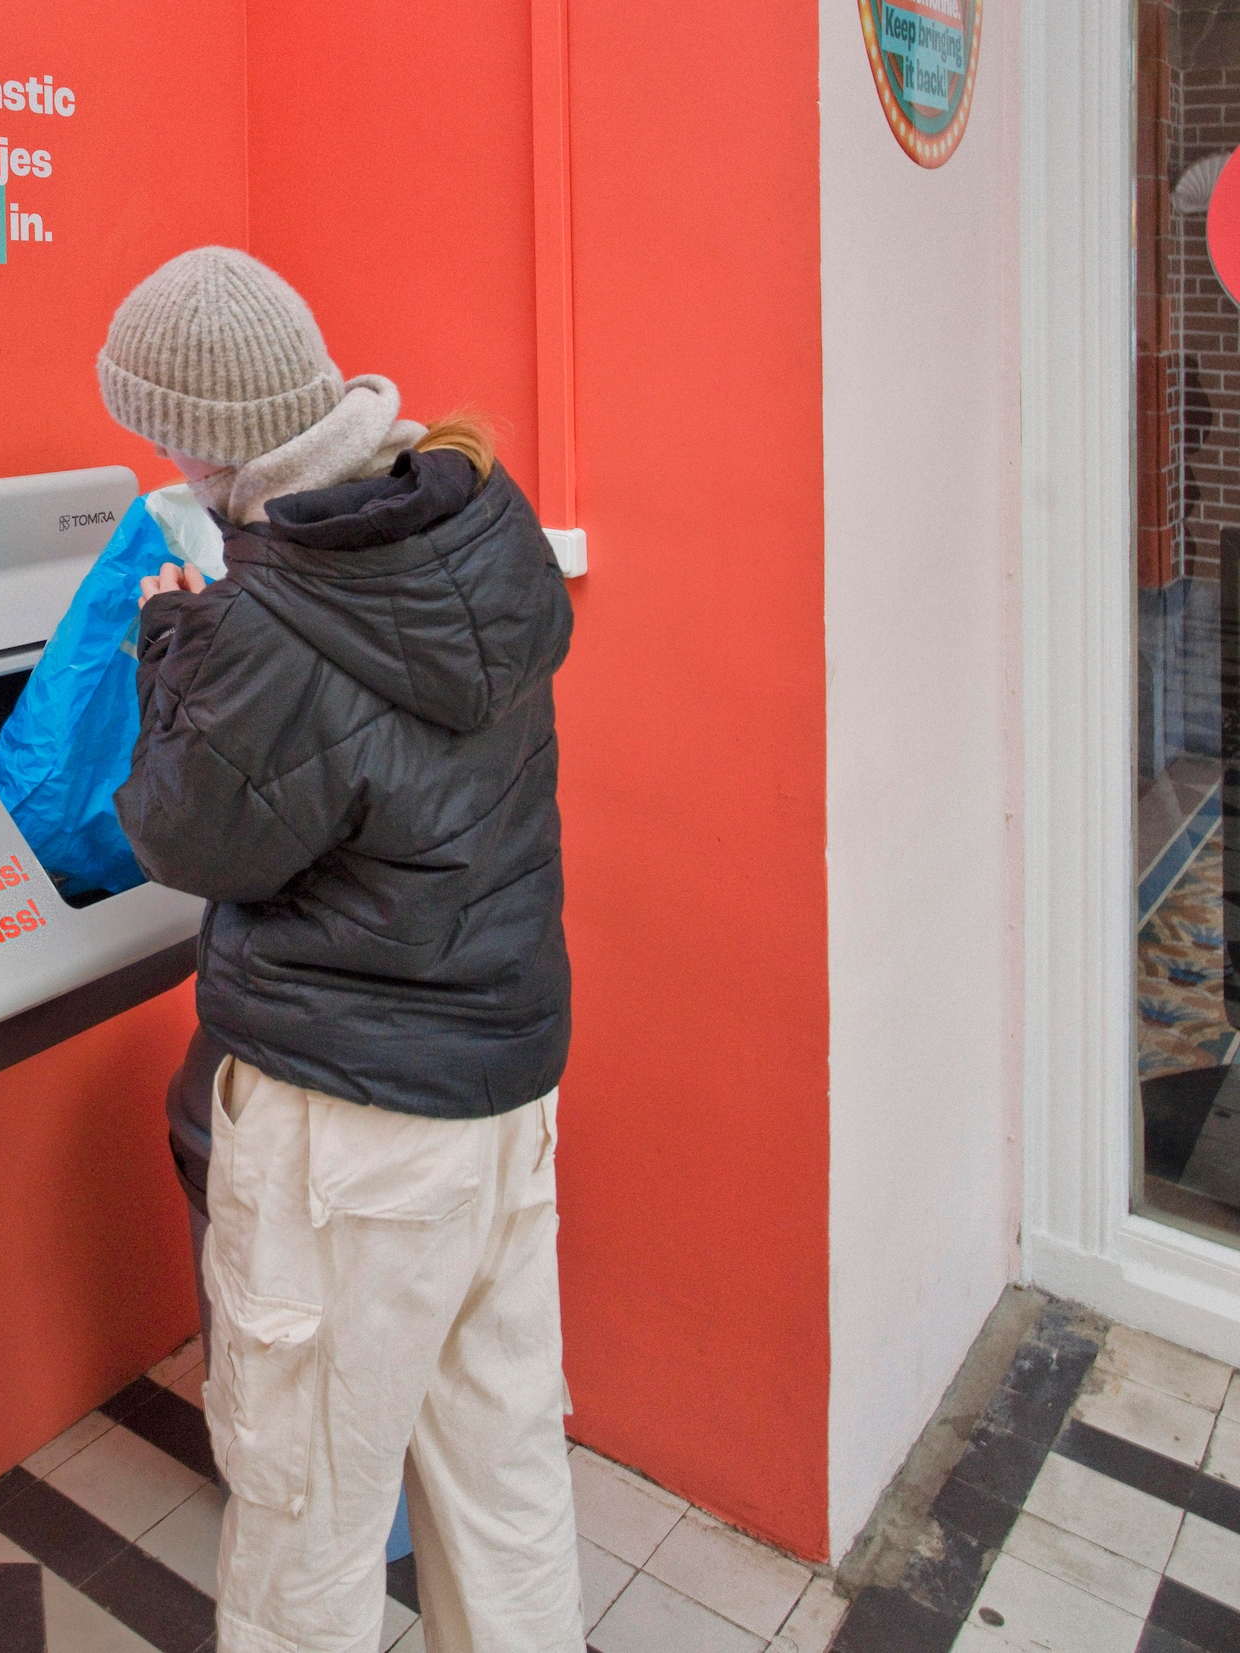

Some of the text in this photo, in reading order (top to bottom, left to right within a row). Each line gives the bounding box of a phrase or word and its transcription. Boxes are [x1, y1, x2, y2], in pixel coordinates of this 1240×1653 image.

[885, 6, 962, 68] Keep bringing
[905, 56, 947, 98] it back!
[10, 203, 53, 242] in.
[71, 511, 116, 527] TOMRA
